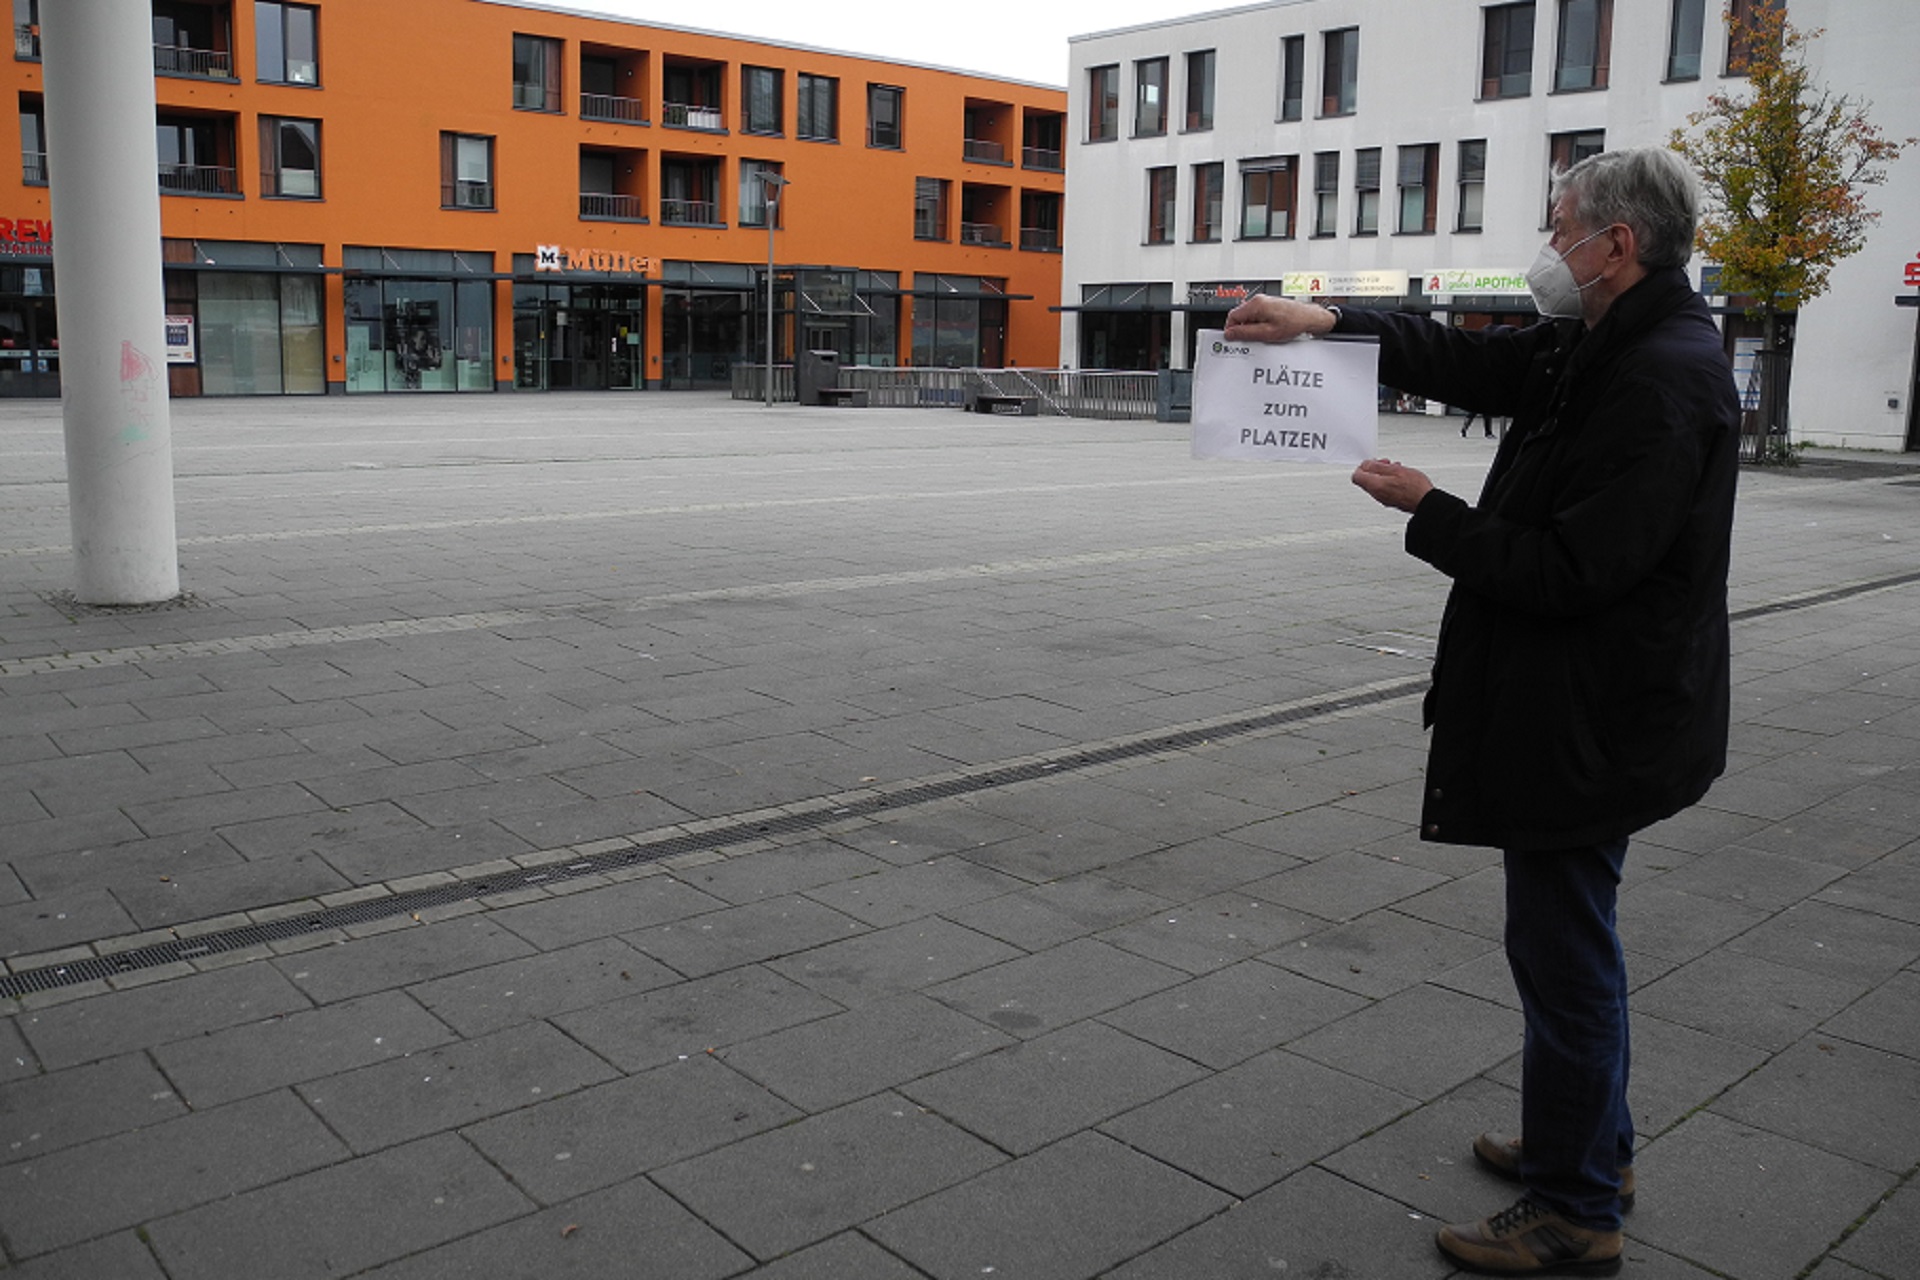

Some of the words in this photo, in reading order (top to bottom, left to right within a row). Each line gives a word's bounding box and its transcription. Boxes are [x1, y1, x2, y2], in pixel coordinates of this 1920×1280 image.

[0, 218, 52, 243] REW
[565, 248, 659, 273] Müller
[1474, 277, 1527, 289] APOTHE
[1252, 365, 1324, 388] PLÄTZE
[1263, 402, 1308, 418] zum
[1240, 428, 1328, 450] PLATZEN
